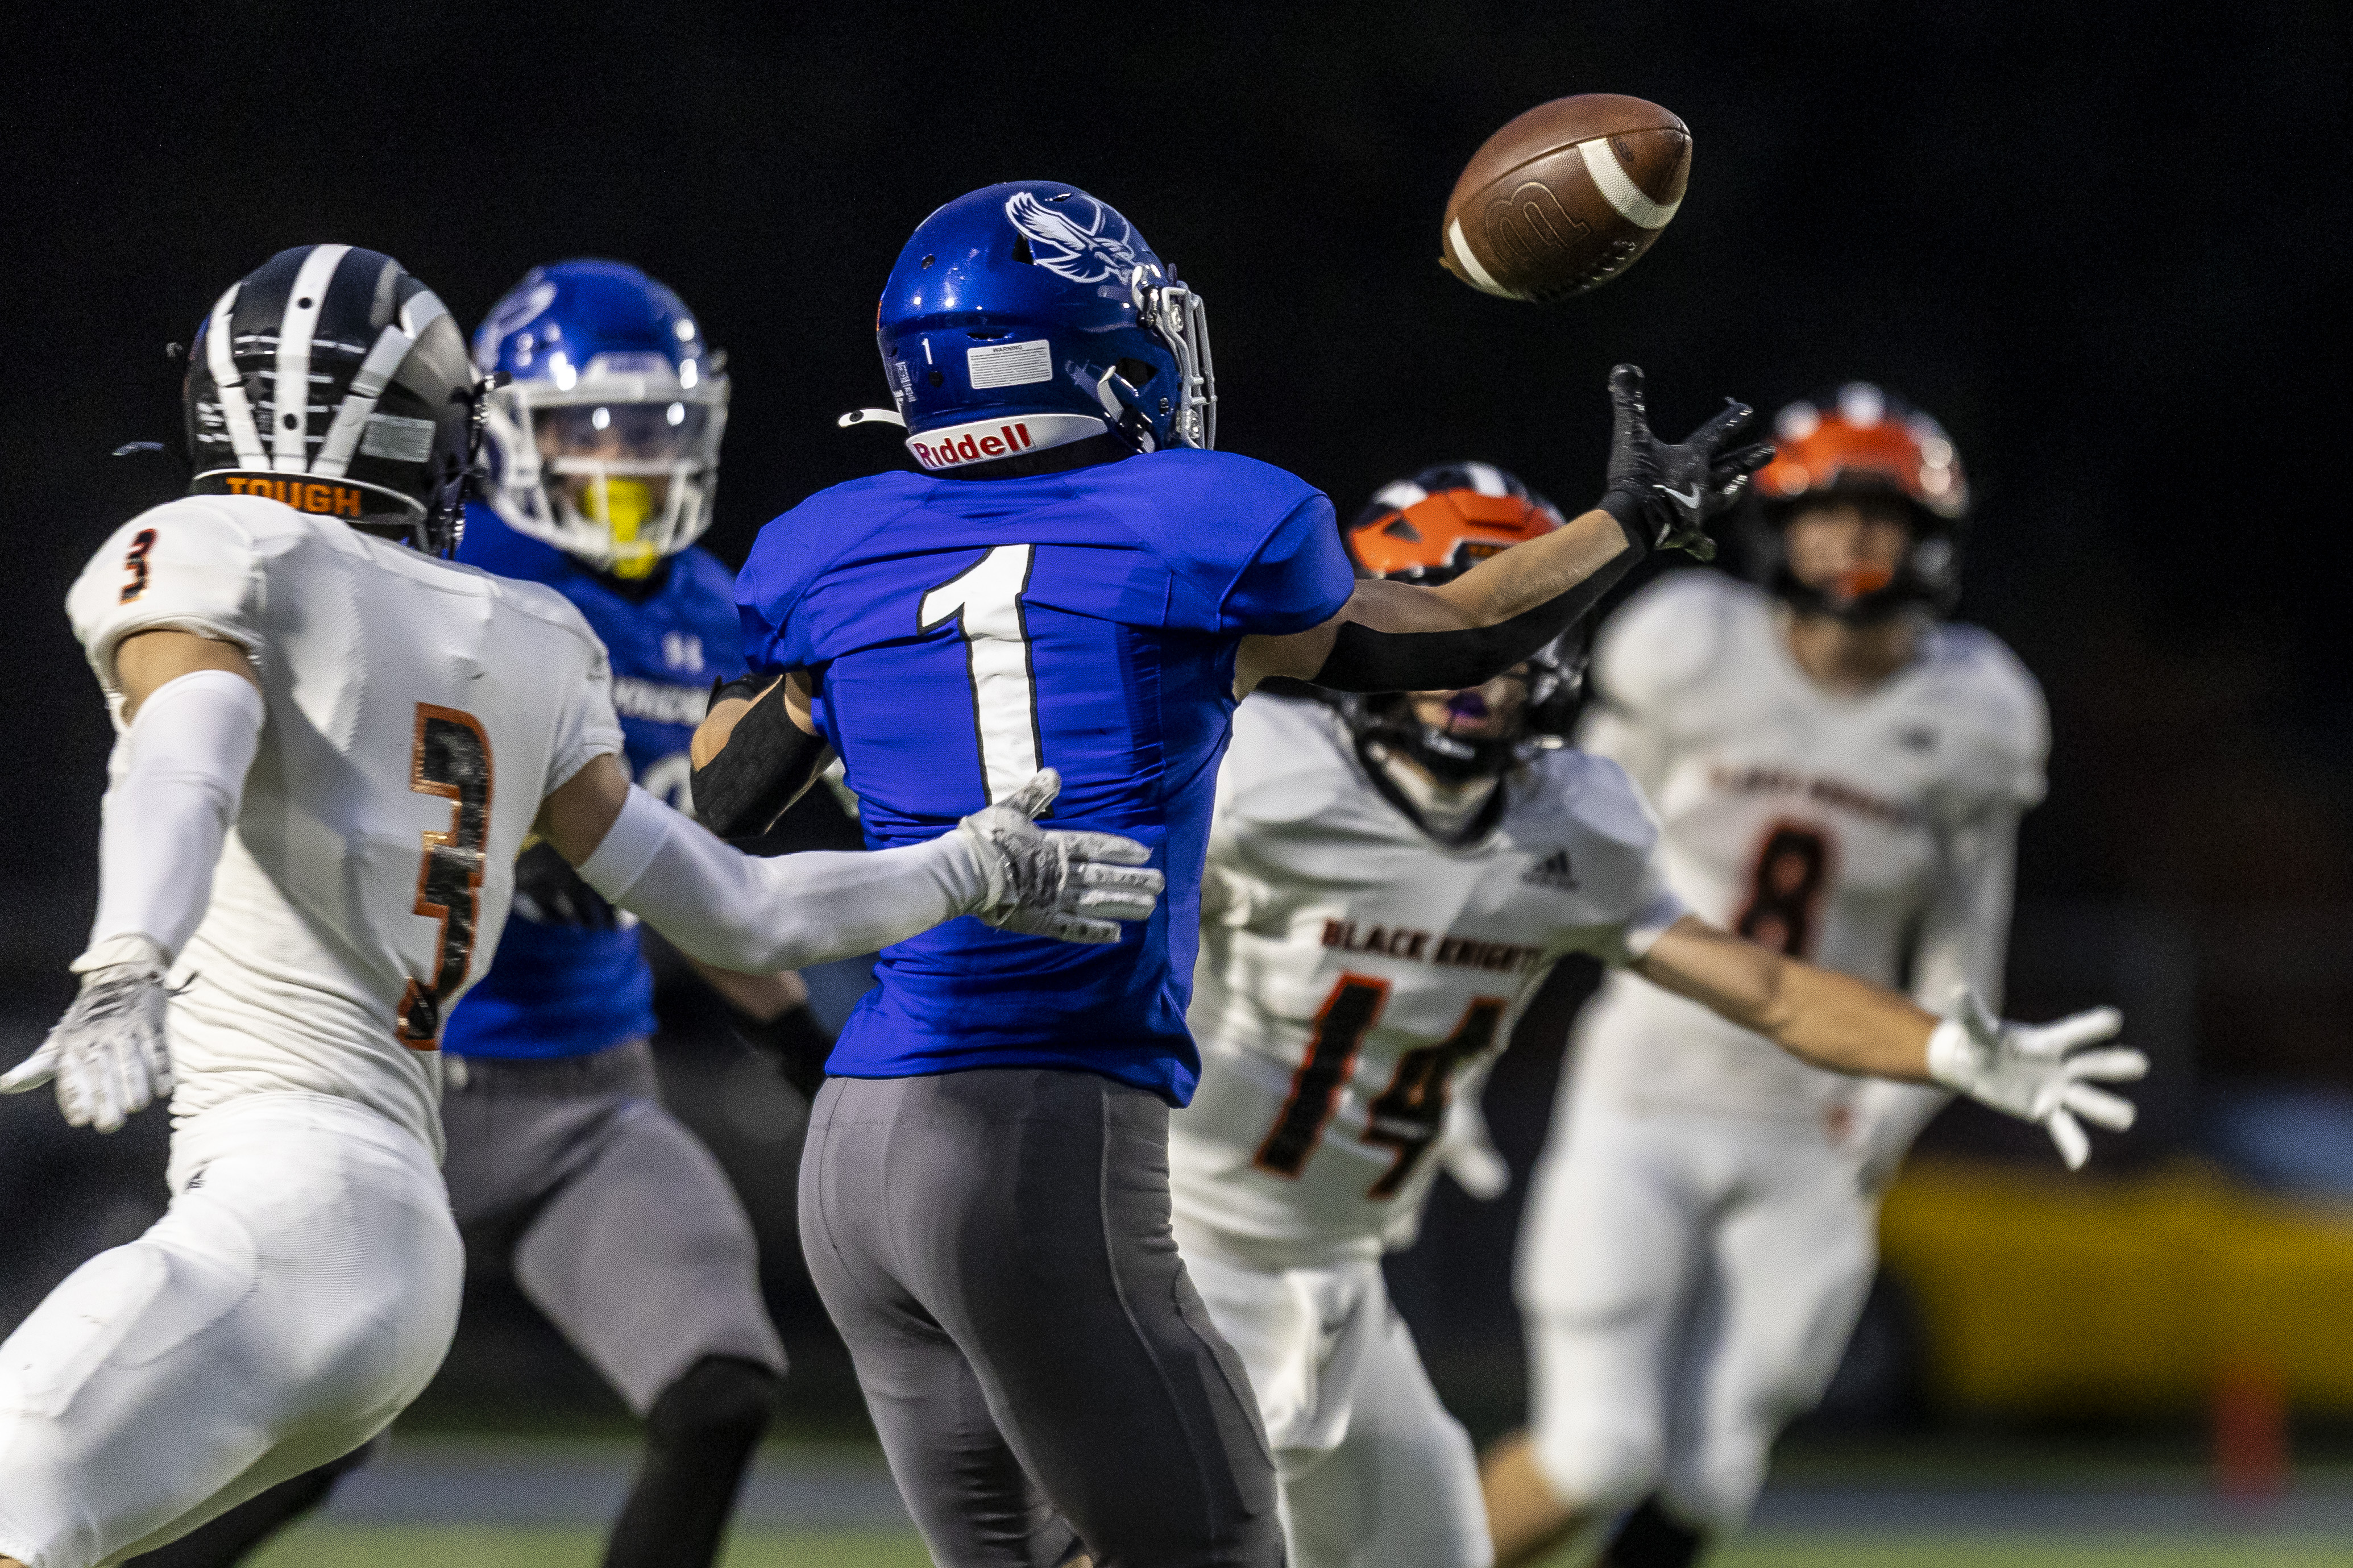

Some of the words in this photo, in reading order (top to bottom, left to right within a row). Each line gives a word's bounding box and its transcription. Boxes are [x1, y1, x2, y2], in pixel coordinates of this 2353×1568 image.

[921, 338, 933, 365] 1
[913, 423, 1032, 467] Riddell
[226, 477, 361, 517] TOUGH
[117, 528, 160, 606] 3
[916, 543, 1052, 818] 1
[396, 702, 495, 1051] 3
[1735, 817, 1839, 959] 8
[1322, 918, 1430, 960] BLACK
[1253, 970, 1509, 1200] 14
